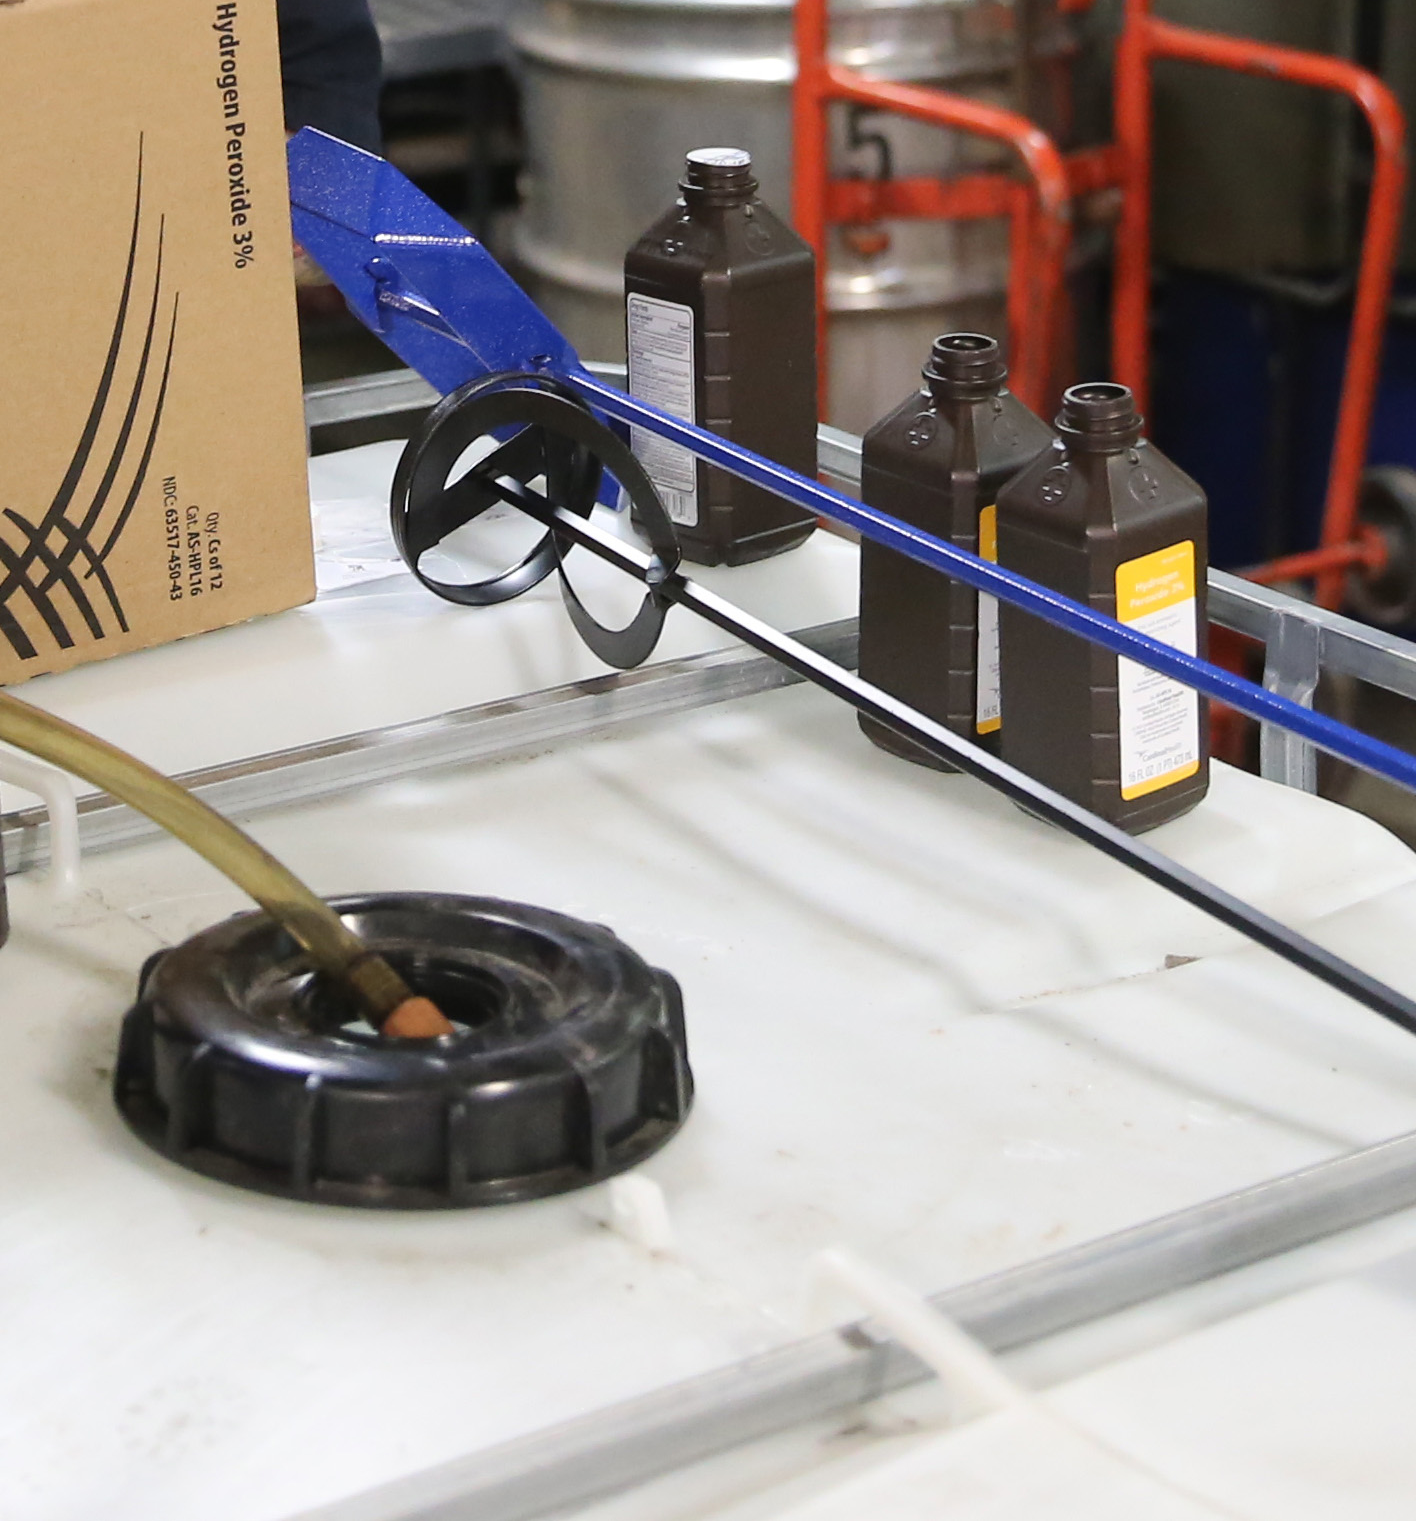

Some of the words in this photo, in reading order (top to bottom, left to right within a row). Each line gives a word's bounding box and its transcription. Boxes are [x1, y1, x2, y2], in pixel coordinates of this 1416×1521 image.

[212, 2, 240, 119] Hydrogen
[225, 122, 251, 227] Peroxide
[233, 231, 254, 269] 3%
[185, 505, 200, 530] Cat.
[204, 512, 220, 538] Qty.
[164, 509, 183, 601] 63517-450-43
[208, 539, 221, 554] Cs
[187, 532, 203, 597] AS-HPL16
[209, 556, 223, 570] of
[210, 572, 223, 591] 12
